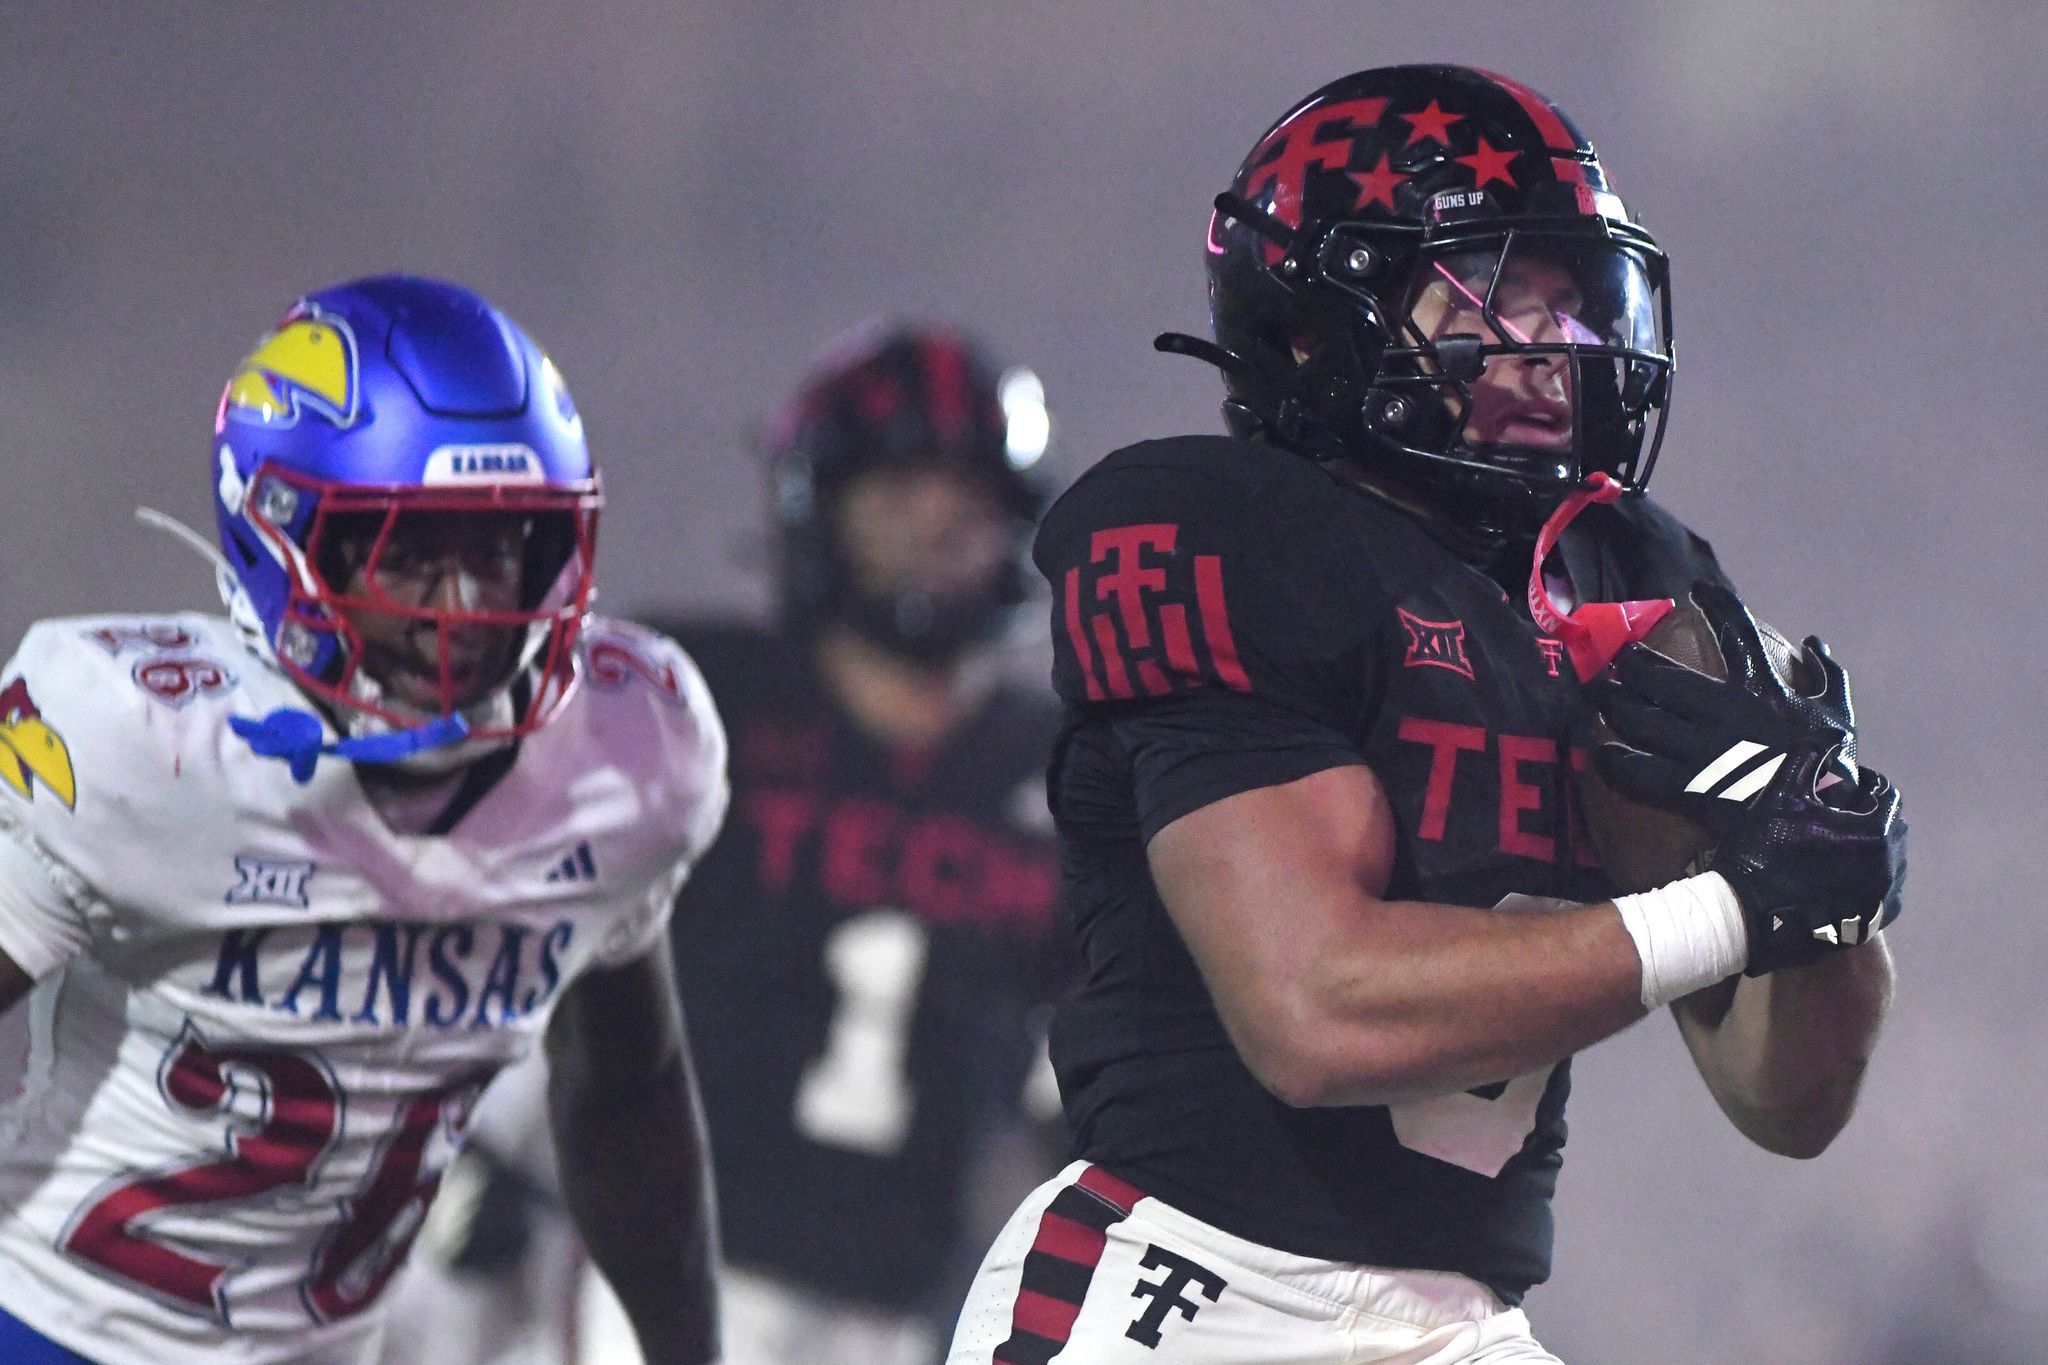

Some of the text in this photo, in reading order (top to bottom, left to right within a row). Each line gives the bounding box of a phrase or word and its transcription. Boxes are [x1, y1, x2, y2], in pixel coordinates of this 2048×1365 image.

[1435, 192, 1483, 210] GUNS UP
[202, 921, 572, 1027] KANSAS
[797, 910, 929, 1155] 1
